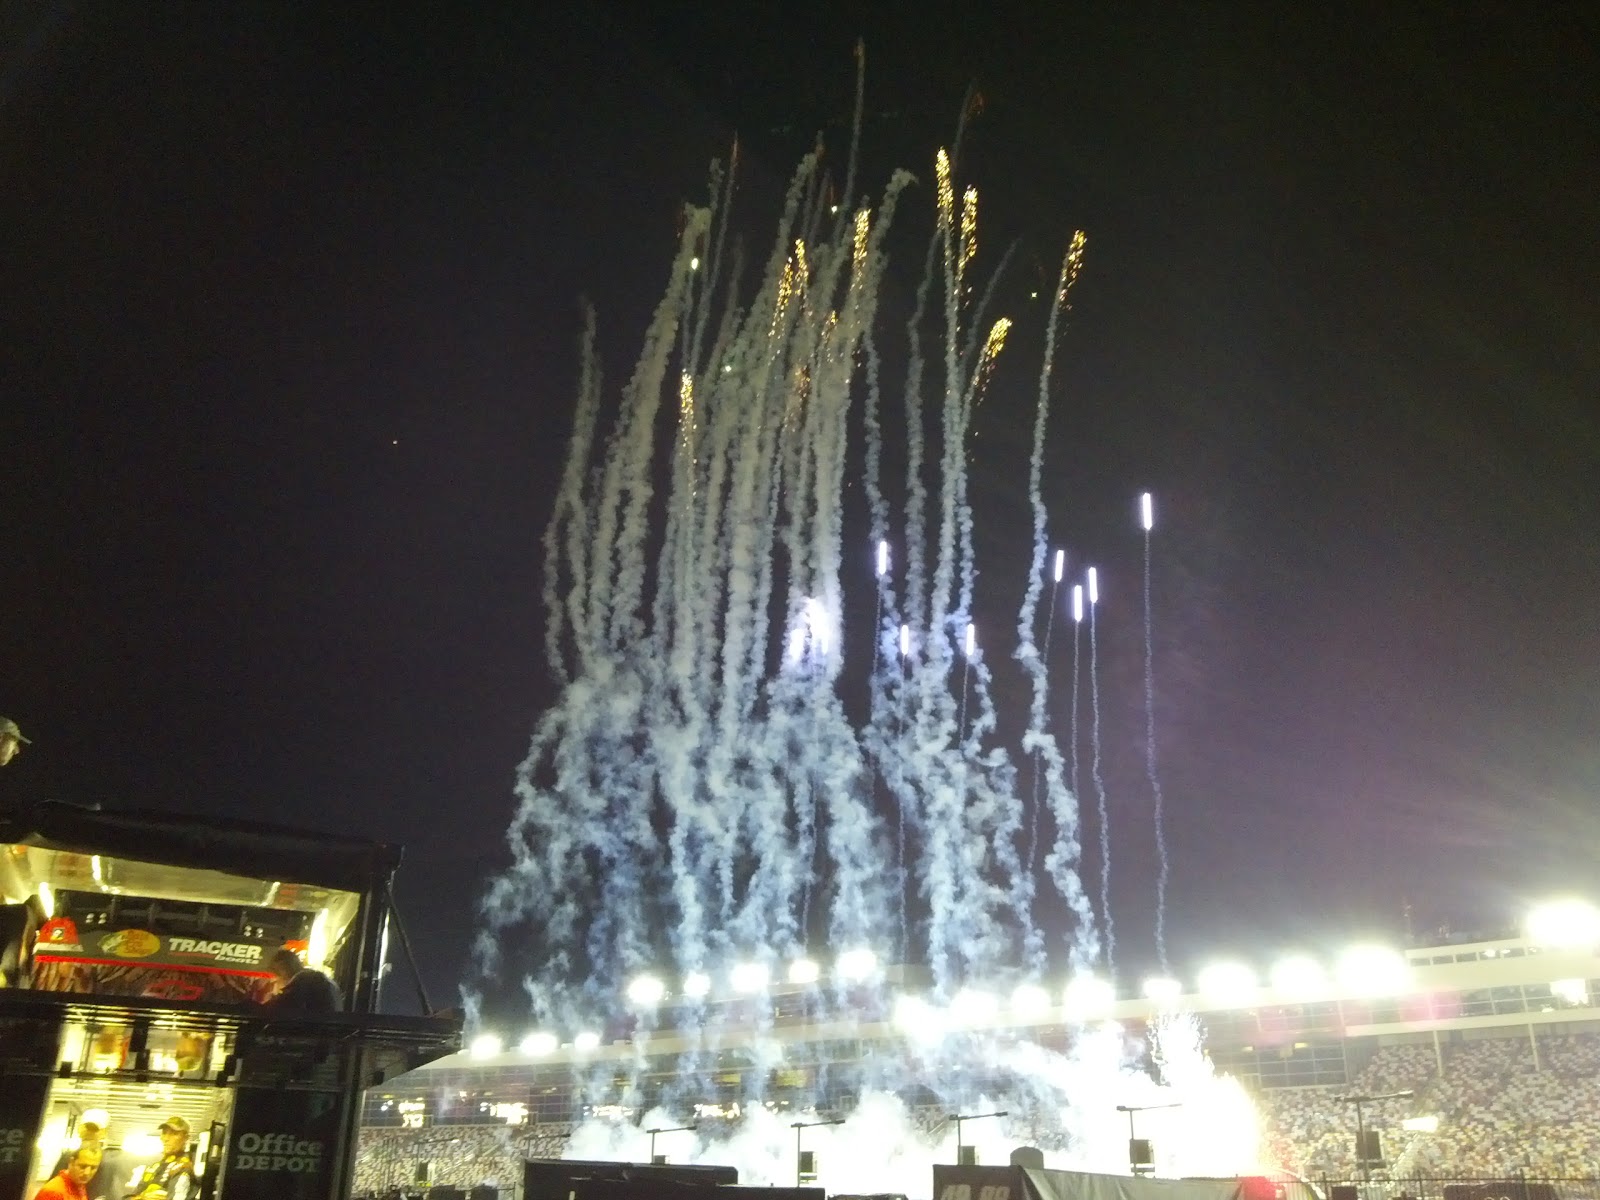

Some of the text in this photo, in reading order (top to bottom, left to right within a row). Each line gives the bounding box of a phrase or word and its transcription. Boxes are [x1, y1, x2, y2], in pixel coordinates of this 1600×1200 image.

[169, 938, 262, 959] TRACKER
[238, 1132, 321, 1156] Office
[235, 1155, 321, 1173] DEPOT
